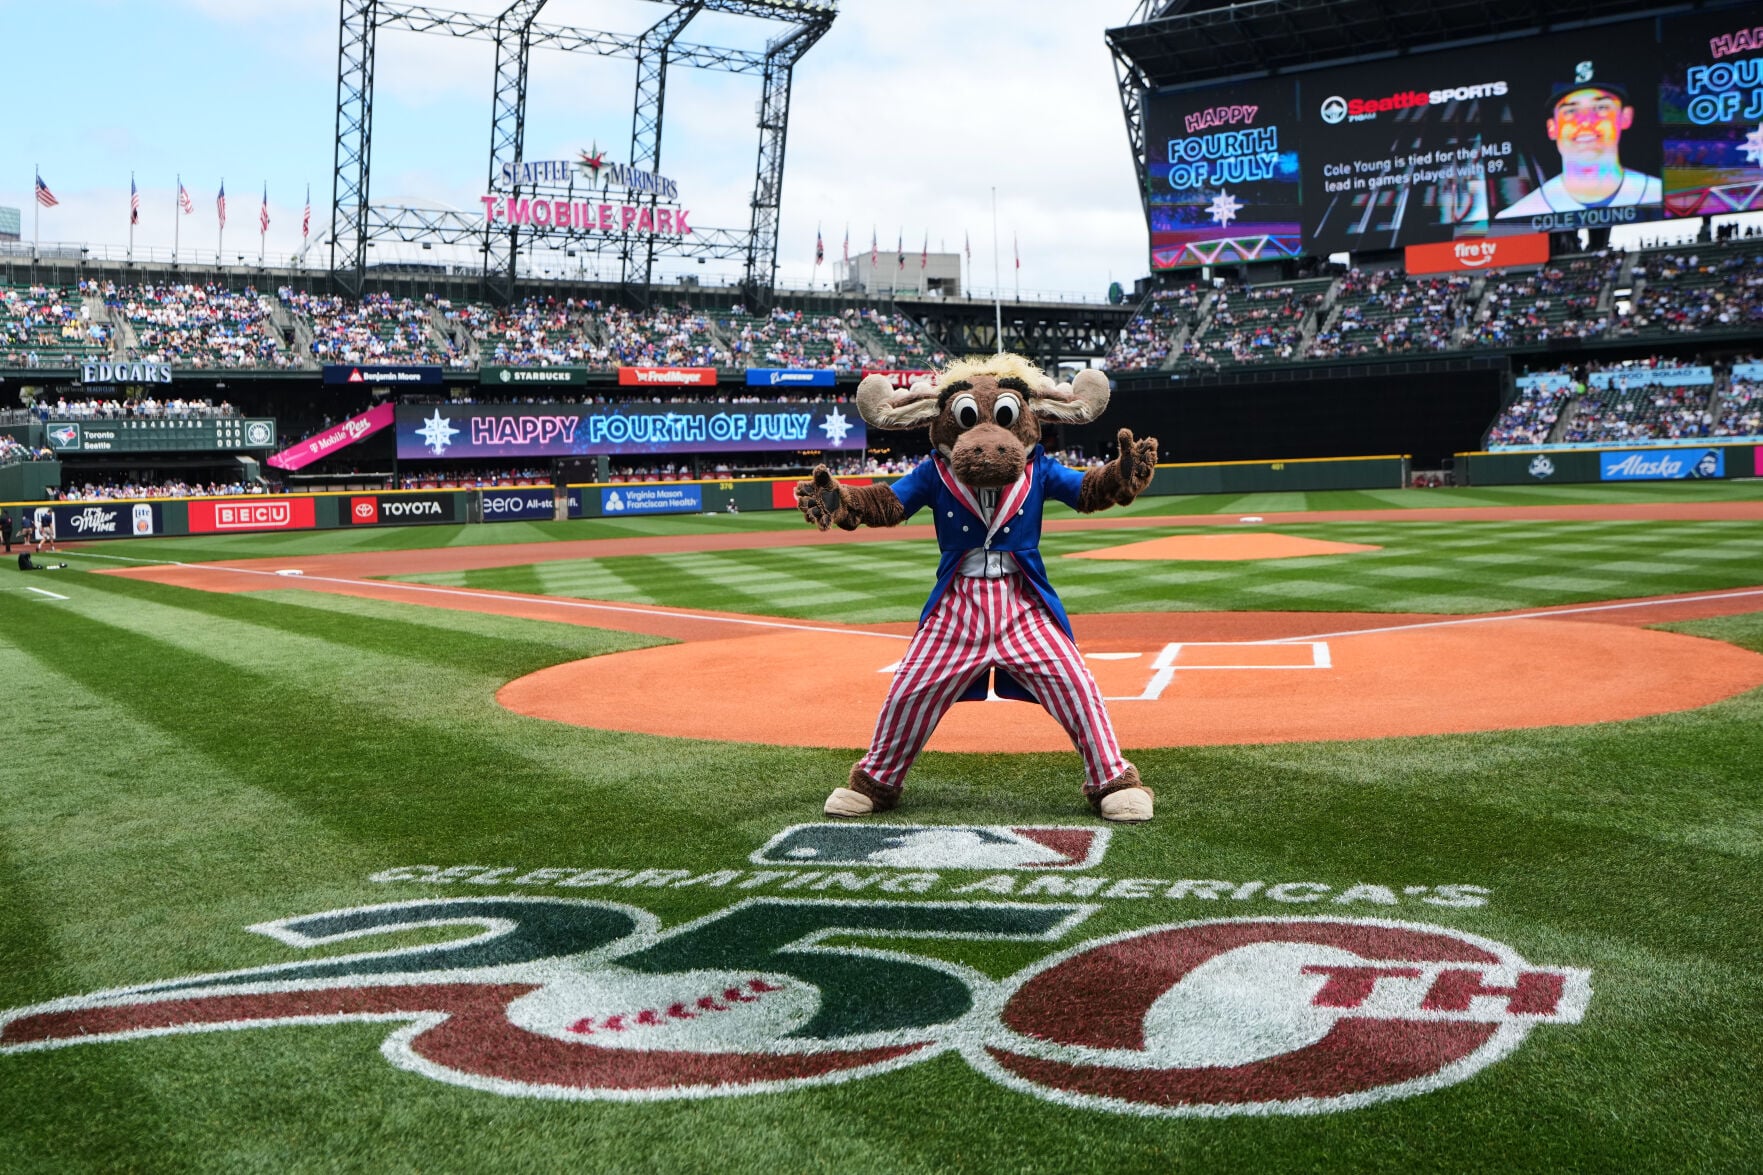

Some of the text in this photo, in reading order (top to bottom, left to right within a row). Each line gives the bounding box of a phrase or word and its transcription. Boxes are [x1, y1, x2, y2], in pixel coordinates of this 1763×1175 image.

[1688, 90, 1741, 125] OF
[1185, 105, 1258, 133] HAPPY
[1168, 126, 1278, 163] FOURTH
[1324, 142, 1512, 177] Cole Young is tied for the MLB
[502, 160, 678, 199] SEATTLE MARINERS
[1168, 152, 1279, 190] OF JULY
[1325, 178, 1351, 192] lead
[1354, 176, 1365, 188] in
[1368, 172, 1410, 190] games
[1413, 166, 1454, 186] played
[1456, 162, 1484, 177] with
[481, 195, 692, 235] T-MOBILE PARK
[1531, 207, 1636, 230] COLE YOUNG
[1455, 242, 1496, 258] fire tv
[83, 364, 171, 383] EDGARS
[364, 372, 421, 383] Benjamin Moore
[514, 371, 571, 381] STARBUCKS
[216, 420, 222, 428] R
[225, 420, 231, 428] H
[235, 420, 240, 428] E
[318, 431, 347, 449] Mobile
[343, 418, 371, 438] Pen
[471, 413, 811, 445] HAPPY FOURTH OF JULY
[84, 431, 115, 439] Toronto
[217, 429, 222, 437] 0
[226, 429, 231, 437] 0
[235, 429, 240, 437] 0
[84, 439, 240, 449] Seattle 0 0 0
[1607, 454, 1682, 476] Alaska
[626, 489, 682, 502] Virginia Mason
[719, 482, 733, 491] 376
[83, 507, 102, 516] IT'S
[382, 501, 442, 516] TOYOTA
[483, 496, 523, 513] eero
[627, 498, 696, 509] Franciscan Health
[71, 512, 117, 533] Miller
[221, 508, 285, 522] BECU
[93, 522, 116, 533] TIME
[369, 864, 1493, 908] CELEBRATING AMERICA'S
